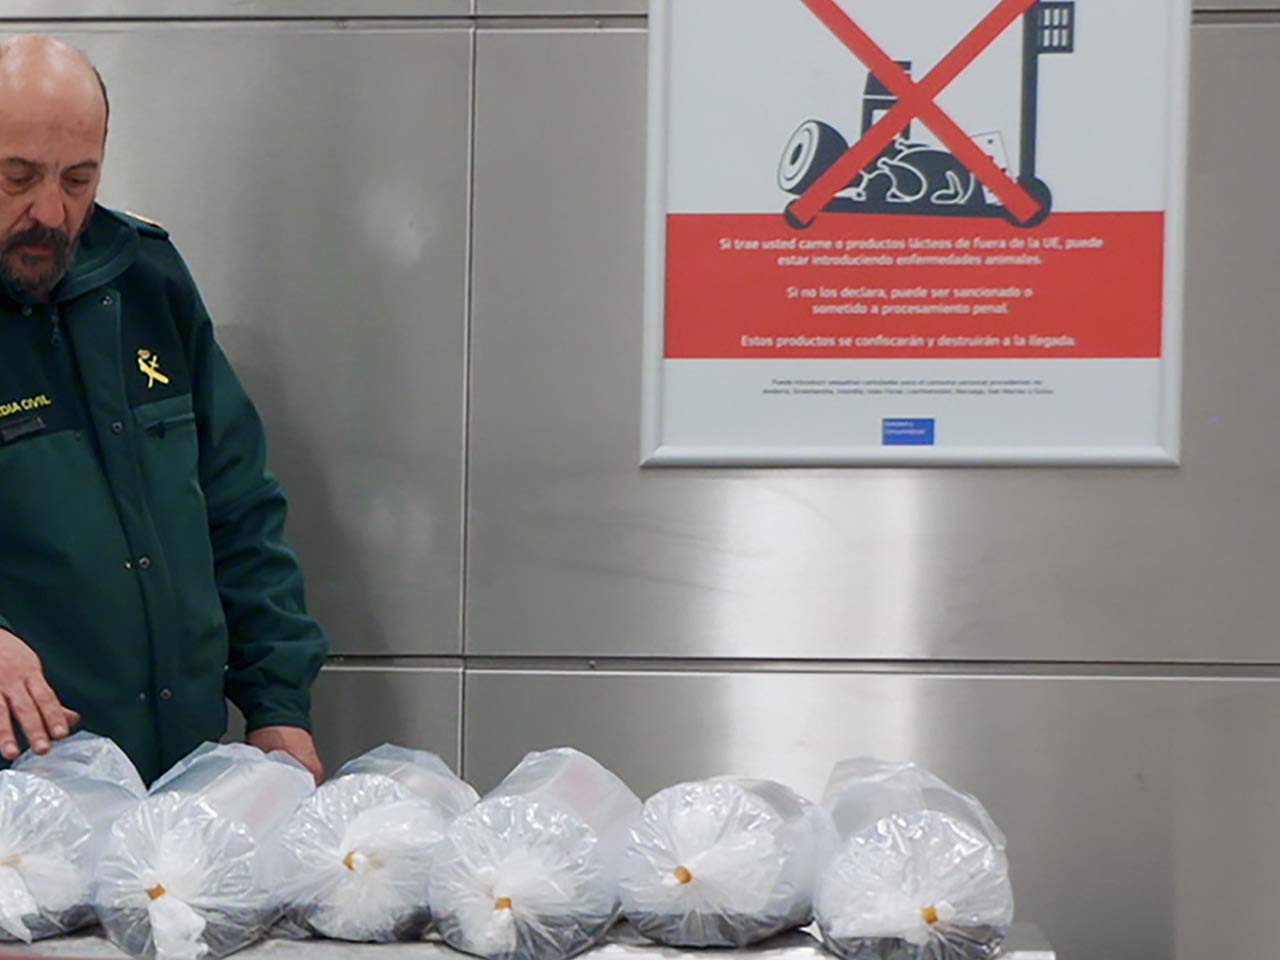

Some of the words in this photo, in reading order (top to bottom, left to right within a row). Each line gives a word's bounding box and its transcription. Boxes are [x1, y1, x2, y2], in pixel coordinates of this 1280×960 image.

[734, 238, 759, 249] trae
[761, 238, 796, 249] usted
[846, 238, 905, 250] productos
[955, 237, 970, 248] de
[973, 237, 1006, 248] fuera
[1009, 237, 1024, 248] de
[1065, 236, 1103, 249] puede
[777, 254, 809, 265] estar
[812, 254, 893, 265] introduciendo
[896, 253, 982, 264] enfermedades
[801, 289, 816, 297] no
[819, 286, 837, 297] los
[890, 286, 927, 299] puede
[931, 289, 950, 297] ser
[953, 286, 1020, 297] sancionado
[812, 303, 867, 314] sometido
[881, 302, 970, 315] procesamiento
[740, 335, 773, 346] Estos
[776, 335, 835, 348] productos
[21, 394, 51, 410] CIVIL
